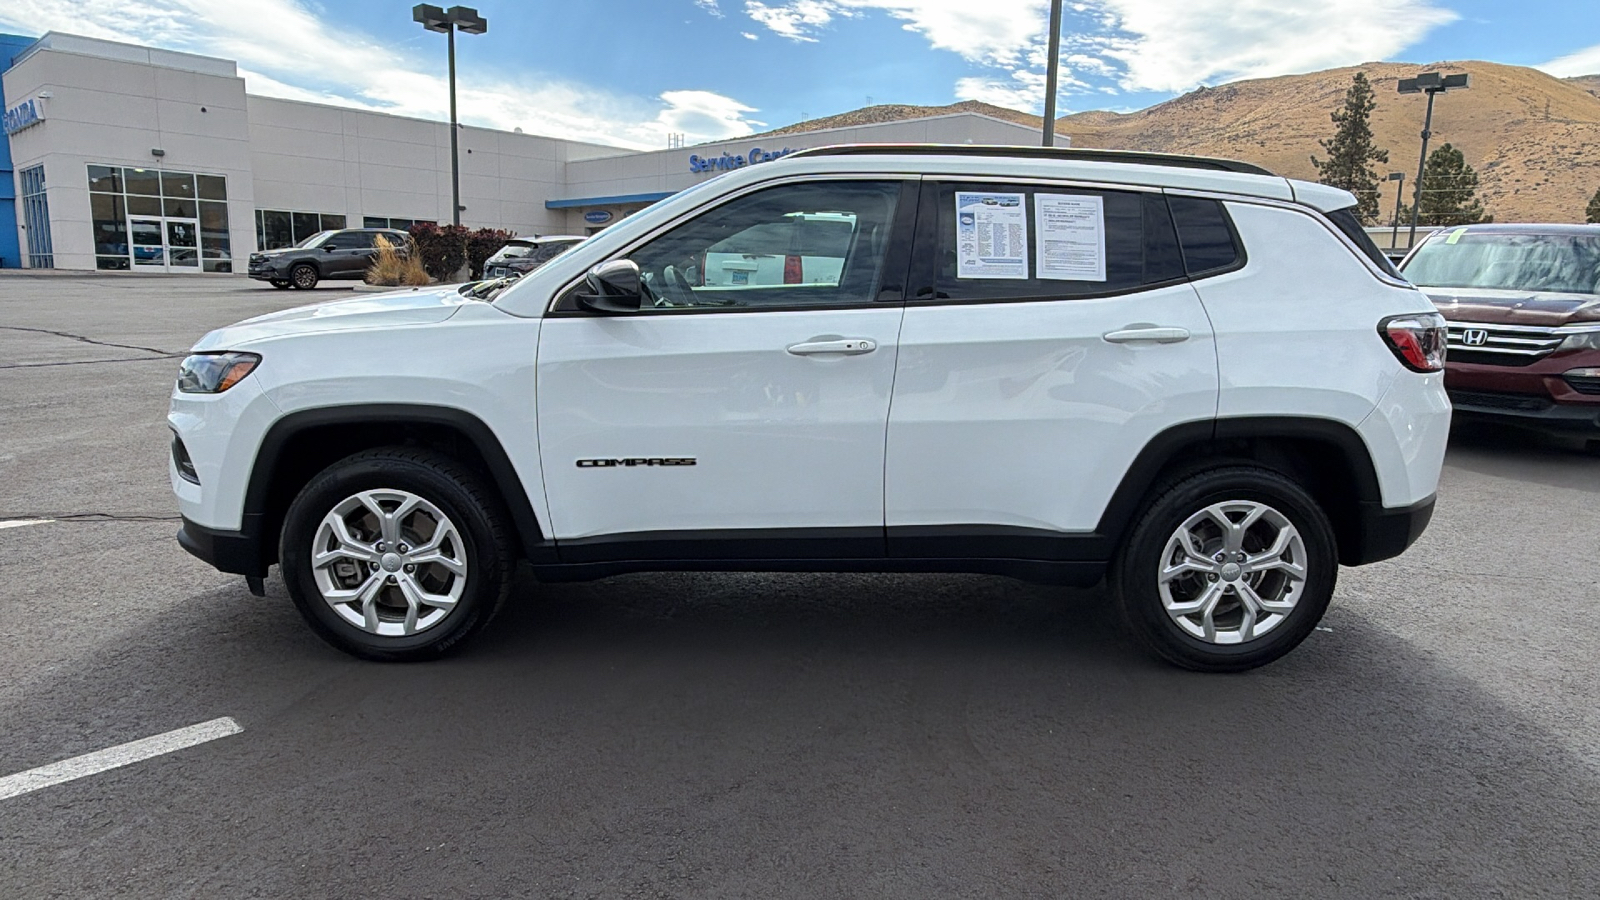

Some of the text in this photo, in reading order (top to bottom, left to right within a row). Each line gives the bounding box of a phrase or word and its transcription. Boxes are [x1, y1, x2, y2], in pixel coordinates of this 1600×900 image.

[689, 147, 808, 173] Service Cent
[576, 458, 697, 467] COMPASS
